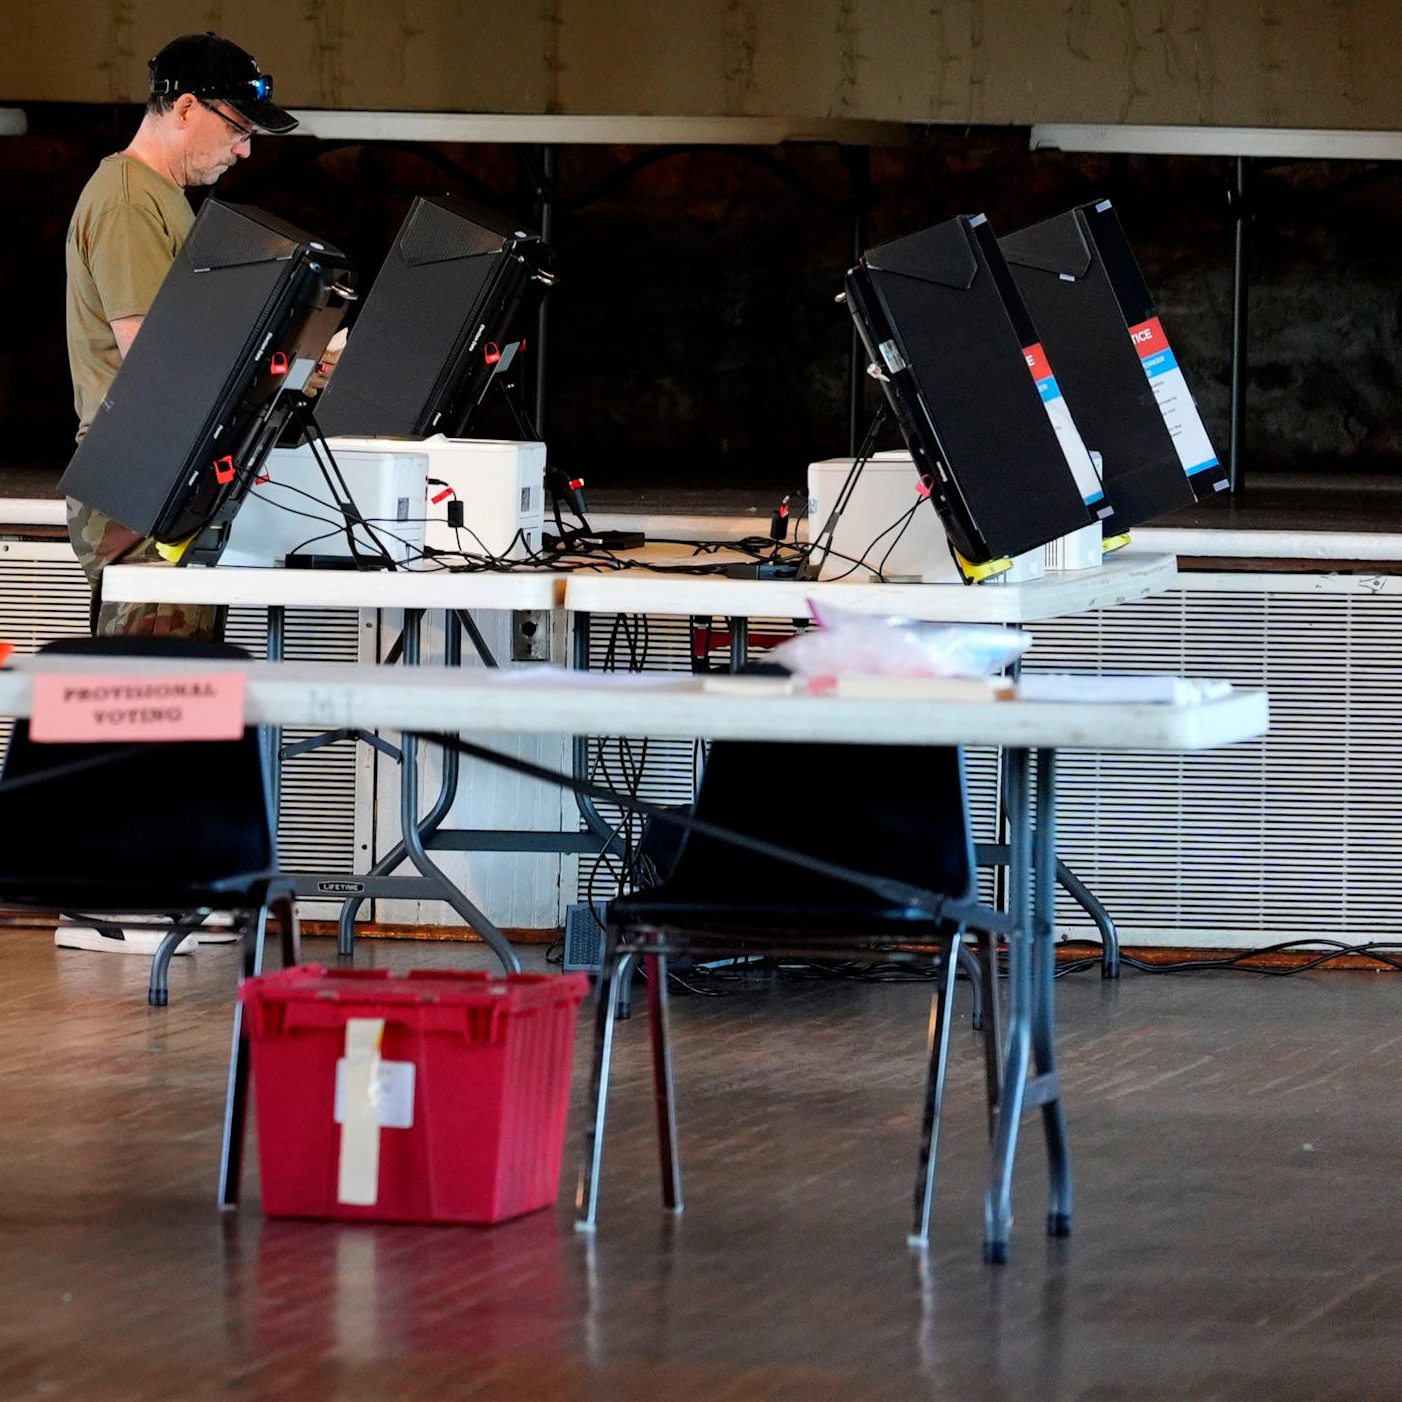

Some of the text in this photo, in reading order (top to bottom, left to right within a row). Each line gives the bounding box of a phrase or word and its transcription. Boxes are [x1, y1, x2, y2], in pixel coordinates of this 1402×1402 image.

[63, 683, 218, 703] PROVISIONAL
[93, 706, 183, 724] VOTING
[323, 883, 359, 891] LIFETIME
